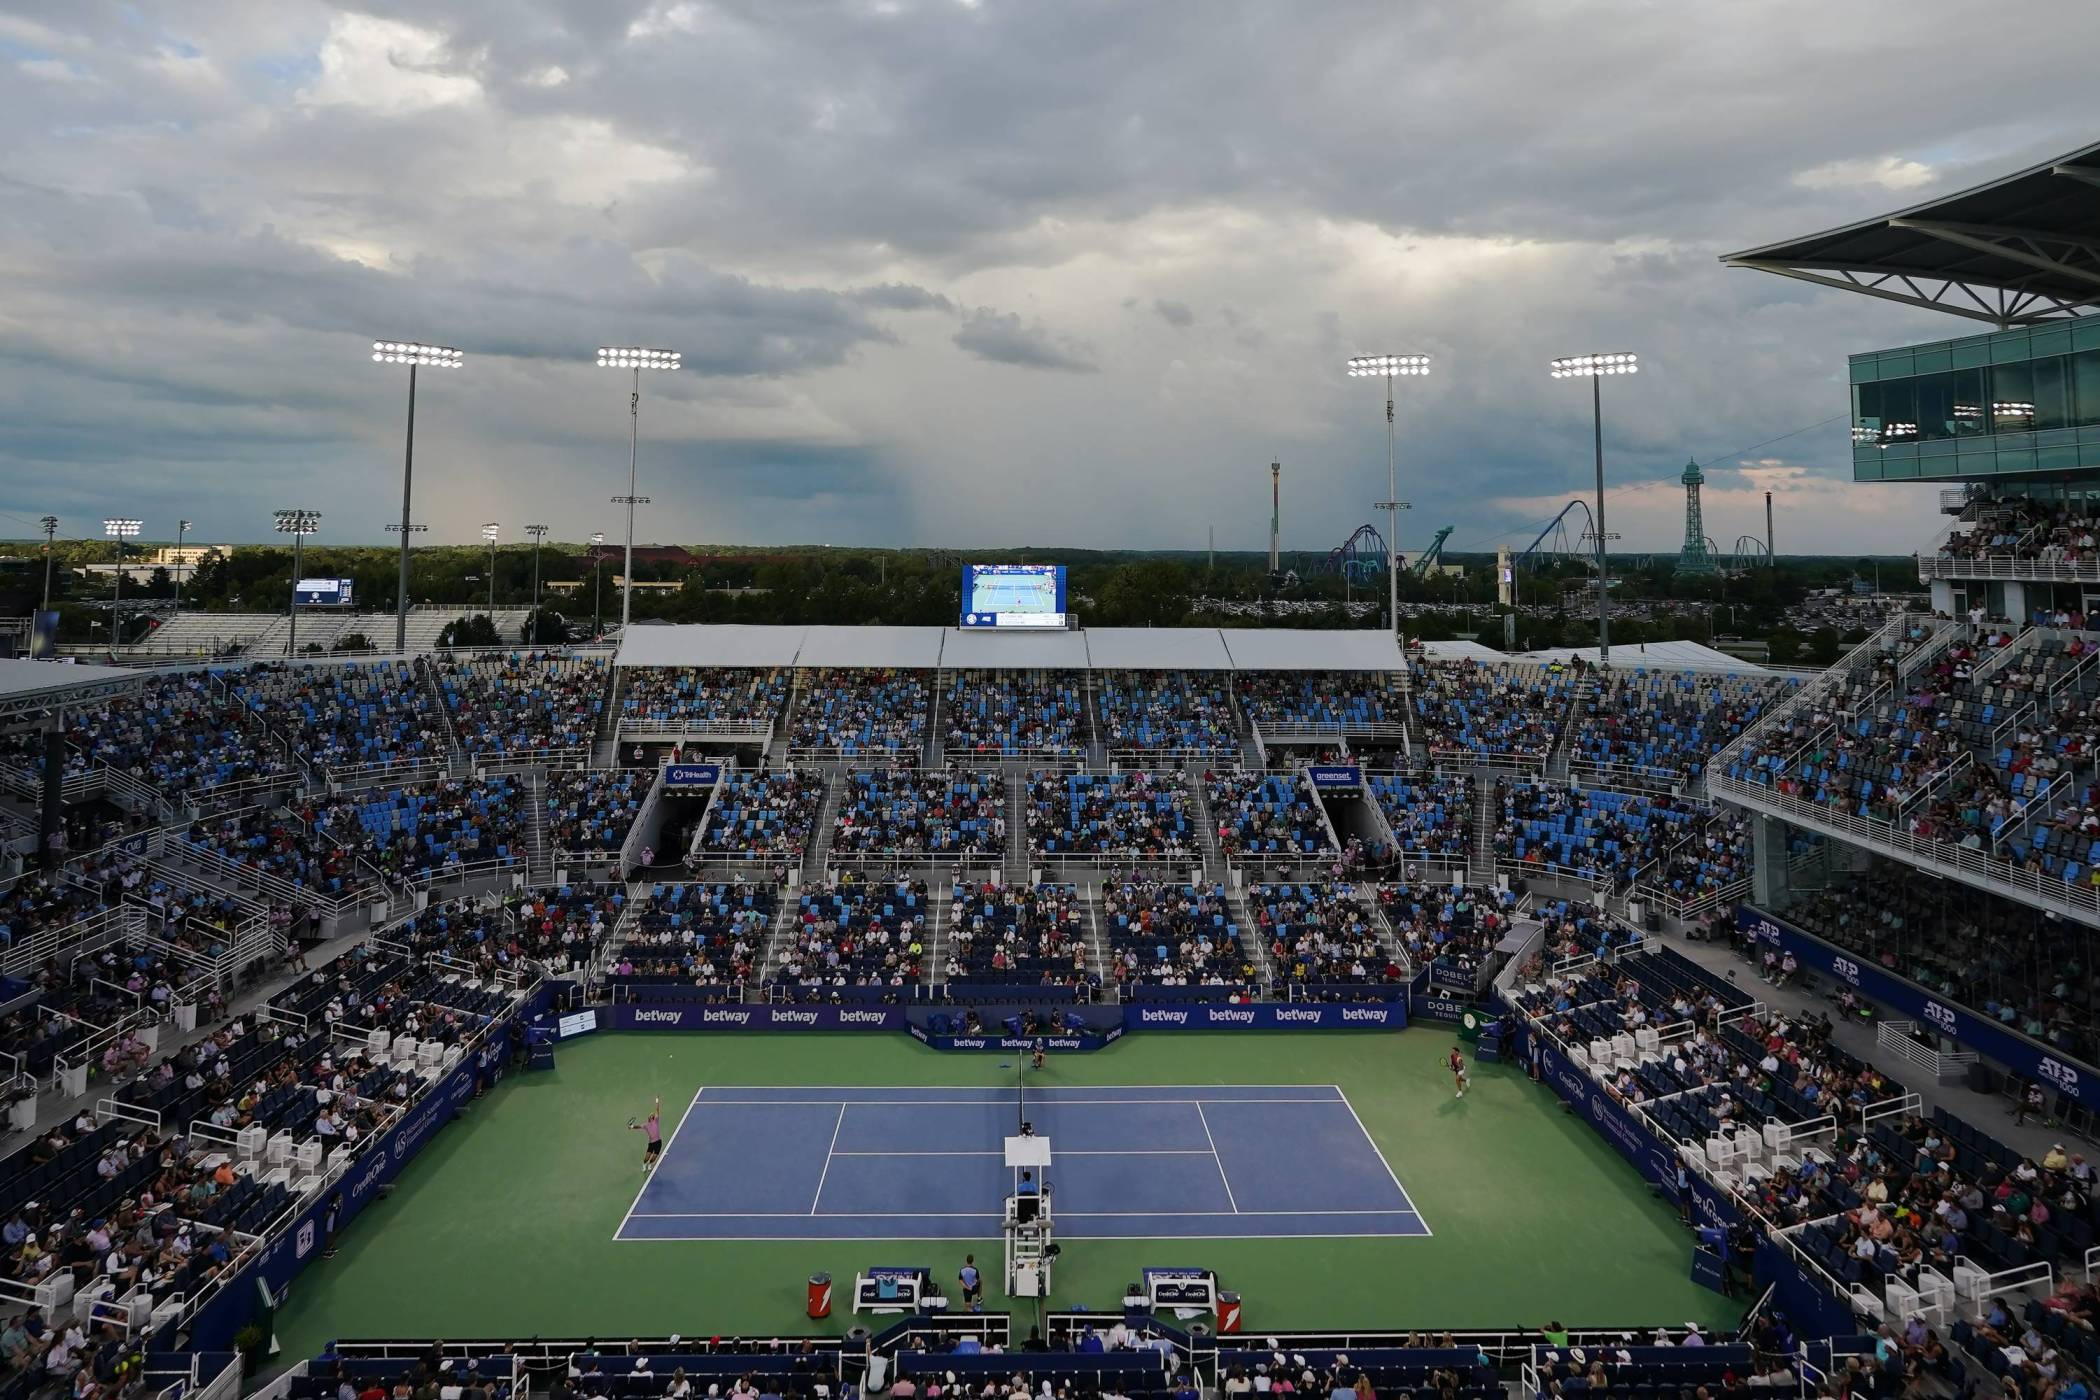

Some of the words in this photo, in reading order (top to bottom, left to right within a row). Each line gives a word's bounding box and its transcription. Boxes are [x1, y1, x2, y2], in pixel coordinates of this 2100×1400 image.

[1758, 920, 1780, 937] ATP
[1768, 937, 1781, 947] 1000
[1832, 956, 1859, 976] ATP
[1846, 975, 1860, 986] 1000
[1428, 1001, 1462, 1012] DOBE
[1923, 1000, 1956, 1023] ATP
[635, 1009, 682, 1024] betway
[704, 1009, 750, 1024] betway
[772, 1009, 818, 1024] betway
[839, 1009, 886, 1024] betway
[1142, 1009, 1188, 1024] betway
[1210, 1009, 1255, 1023] betway
[1276, 1008, 1322, 1022] betway
[1342, 1008, 1388, 1022] betway
[911, 1025, 928, 1042] betway
[1106, 1027, 1122, 1042] betway
[1940, 1022, 1958, 1035] 1000
[954, 1038, 986, 1049] betway
[1002, 1038, 1033, 1049] betway
[1049, 1038, 1080, 1049] betway
[2038, 1056, 2078, 1083] ATP
[2059, 1080, 2080, 1097] 1000
